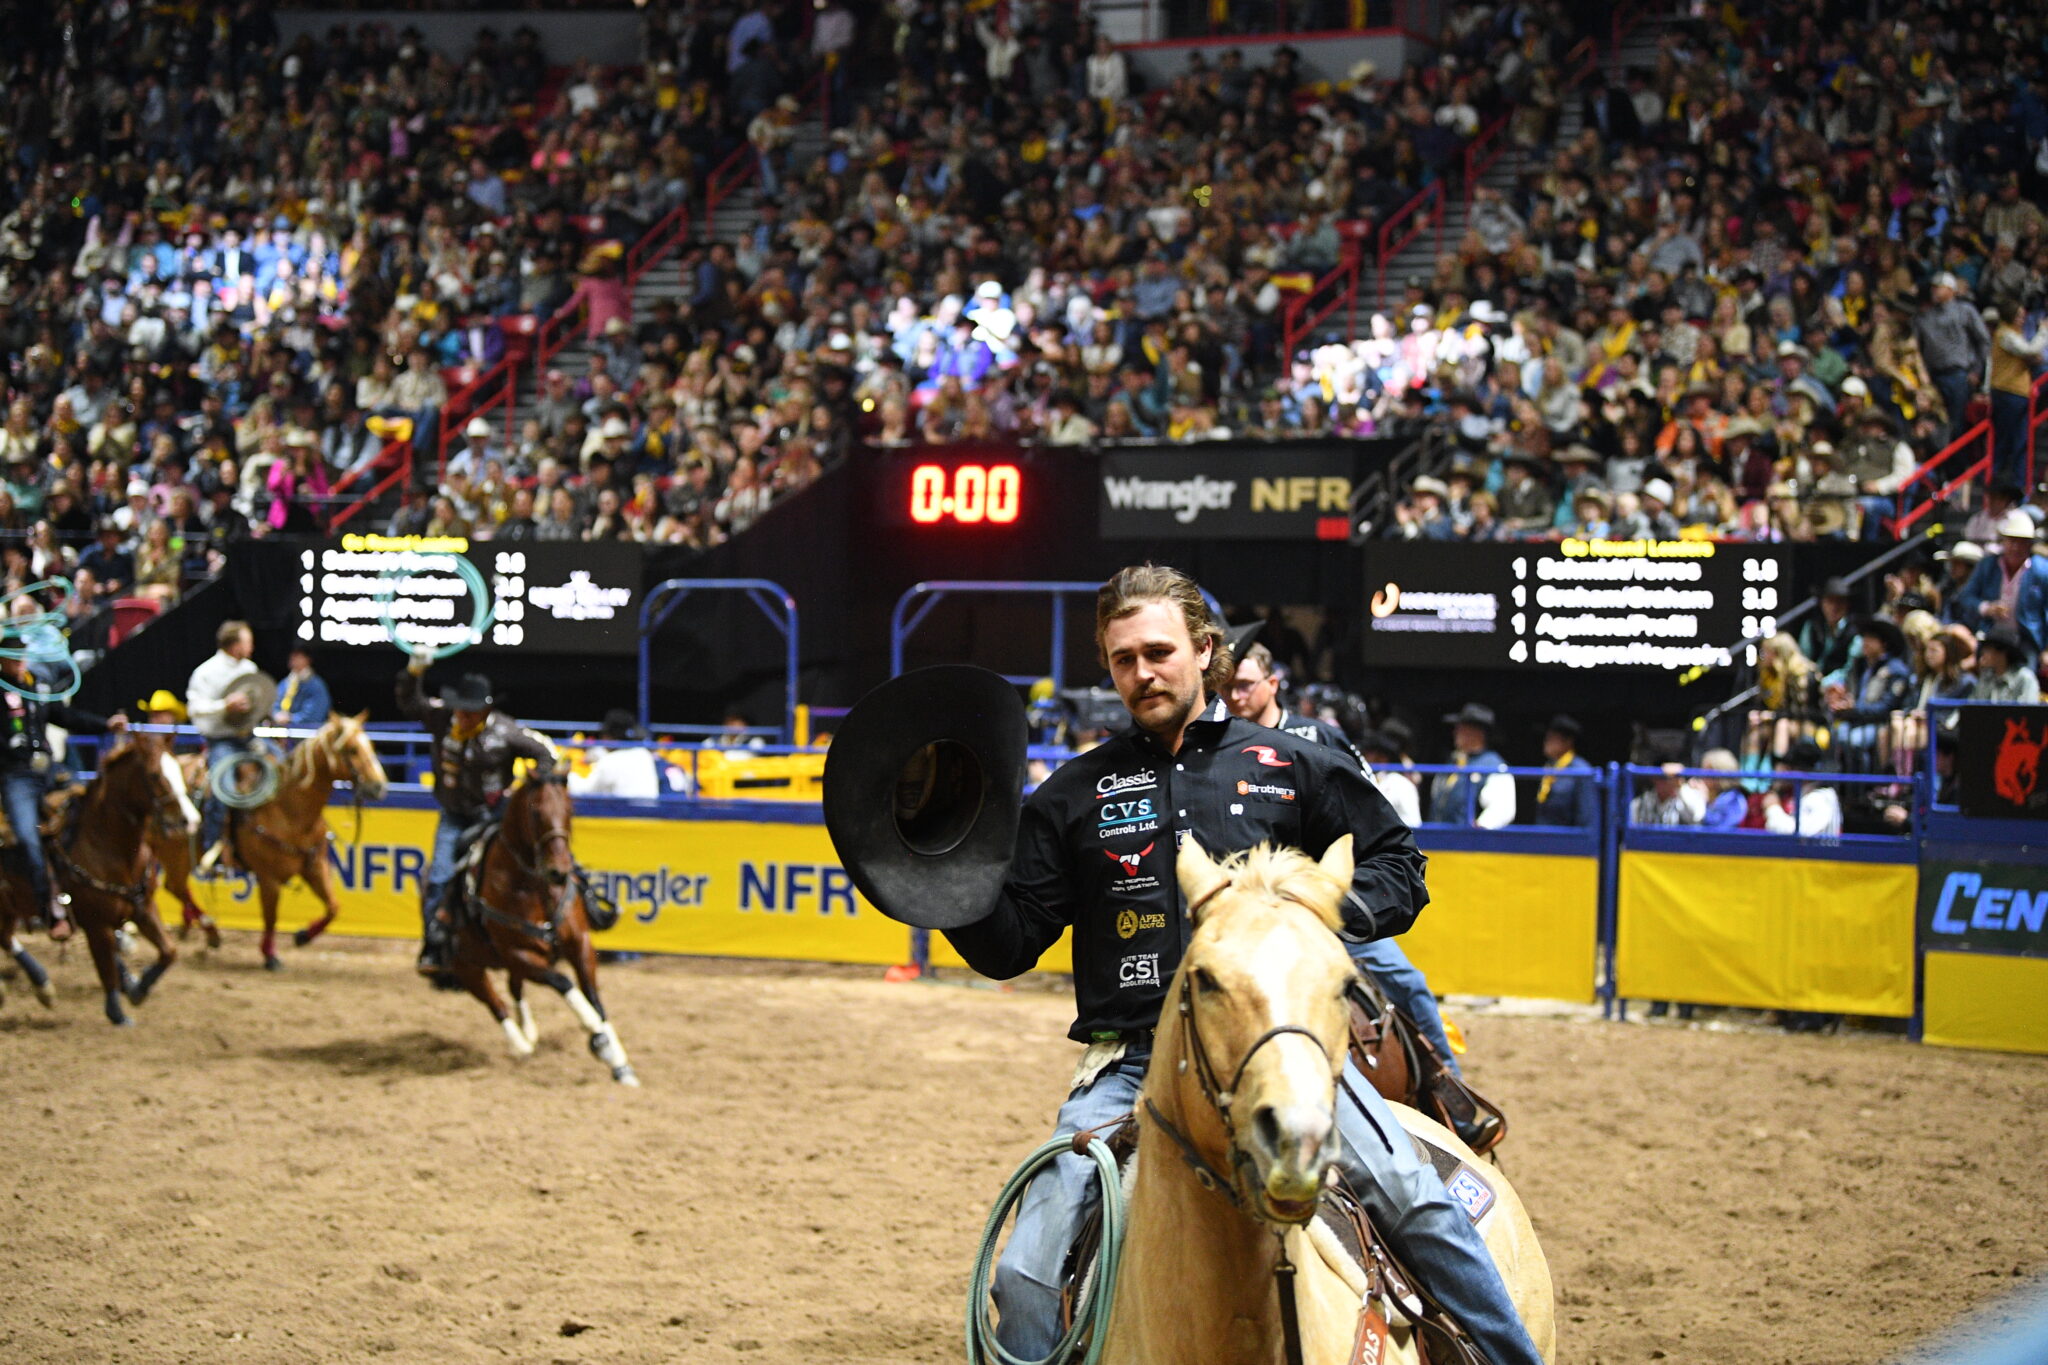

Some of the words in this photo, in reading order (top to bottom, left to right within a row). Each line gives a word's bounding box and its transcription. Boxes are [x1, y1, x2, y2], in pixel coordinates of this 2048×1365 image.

[911, 464, 1020, 524] 0.00
[1104, 474, 1236, 524] Wrangler
[1250, 477, 1352, 512] NFR
[1096, 767, 1157, 793] Classic
[1248, 784, 1296, 796] Brothers
[1100, 798, 1152, 821] CVS
[1099, 825, 1136, 838] Controls
[1139, 820, 1158, 831] Ltd.
[327, 845, 424, 890] NFR
[741, 863, 857, 916] NFR
[1140, 913, 1165, 923] APEX
[1119, 959, 1160, 981] CSI
